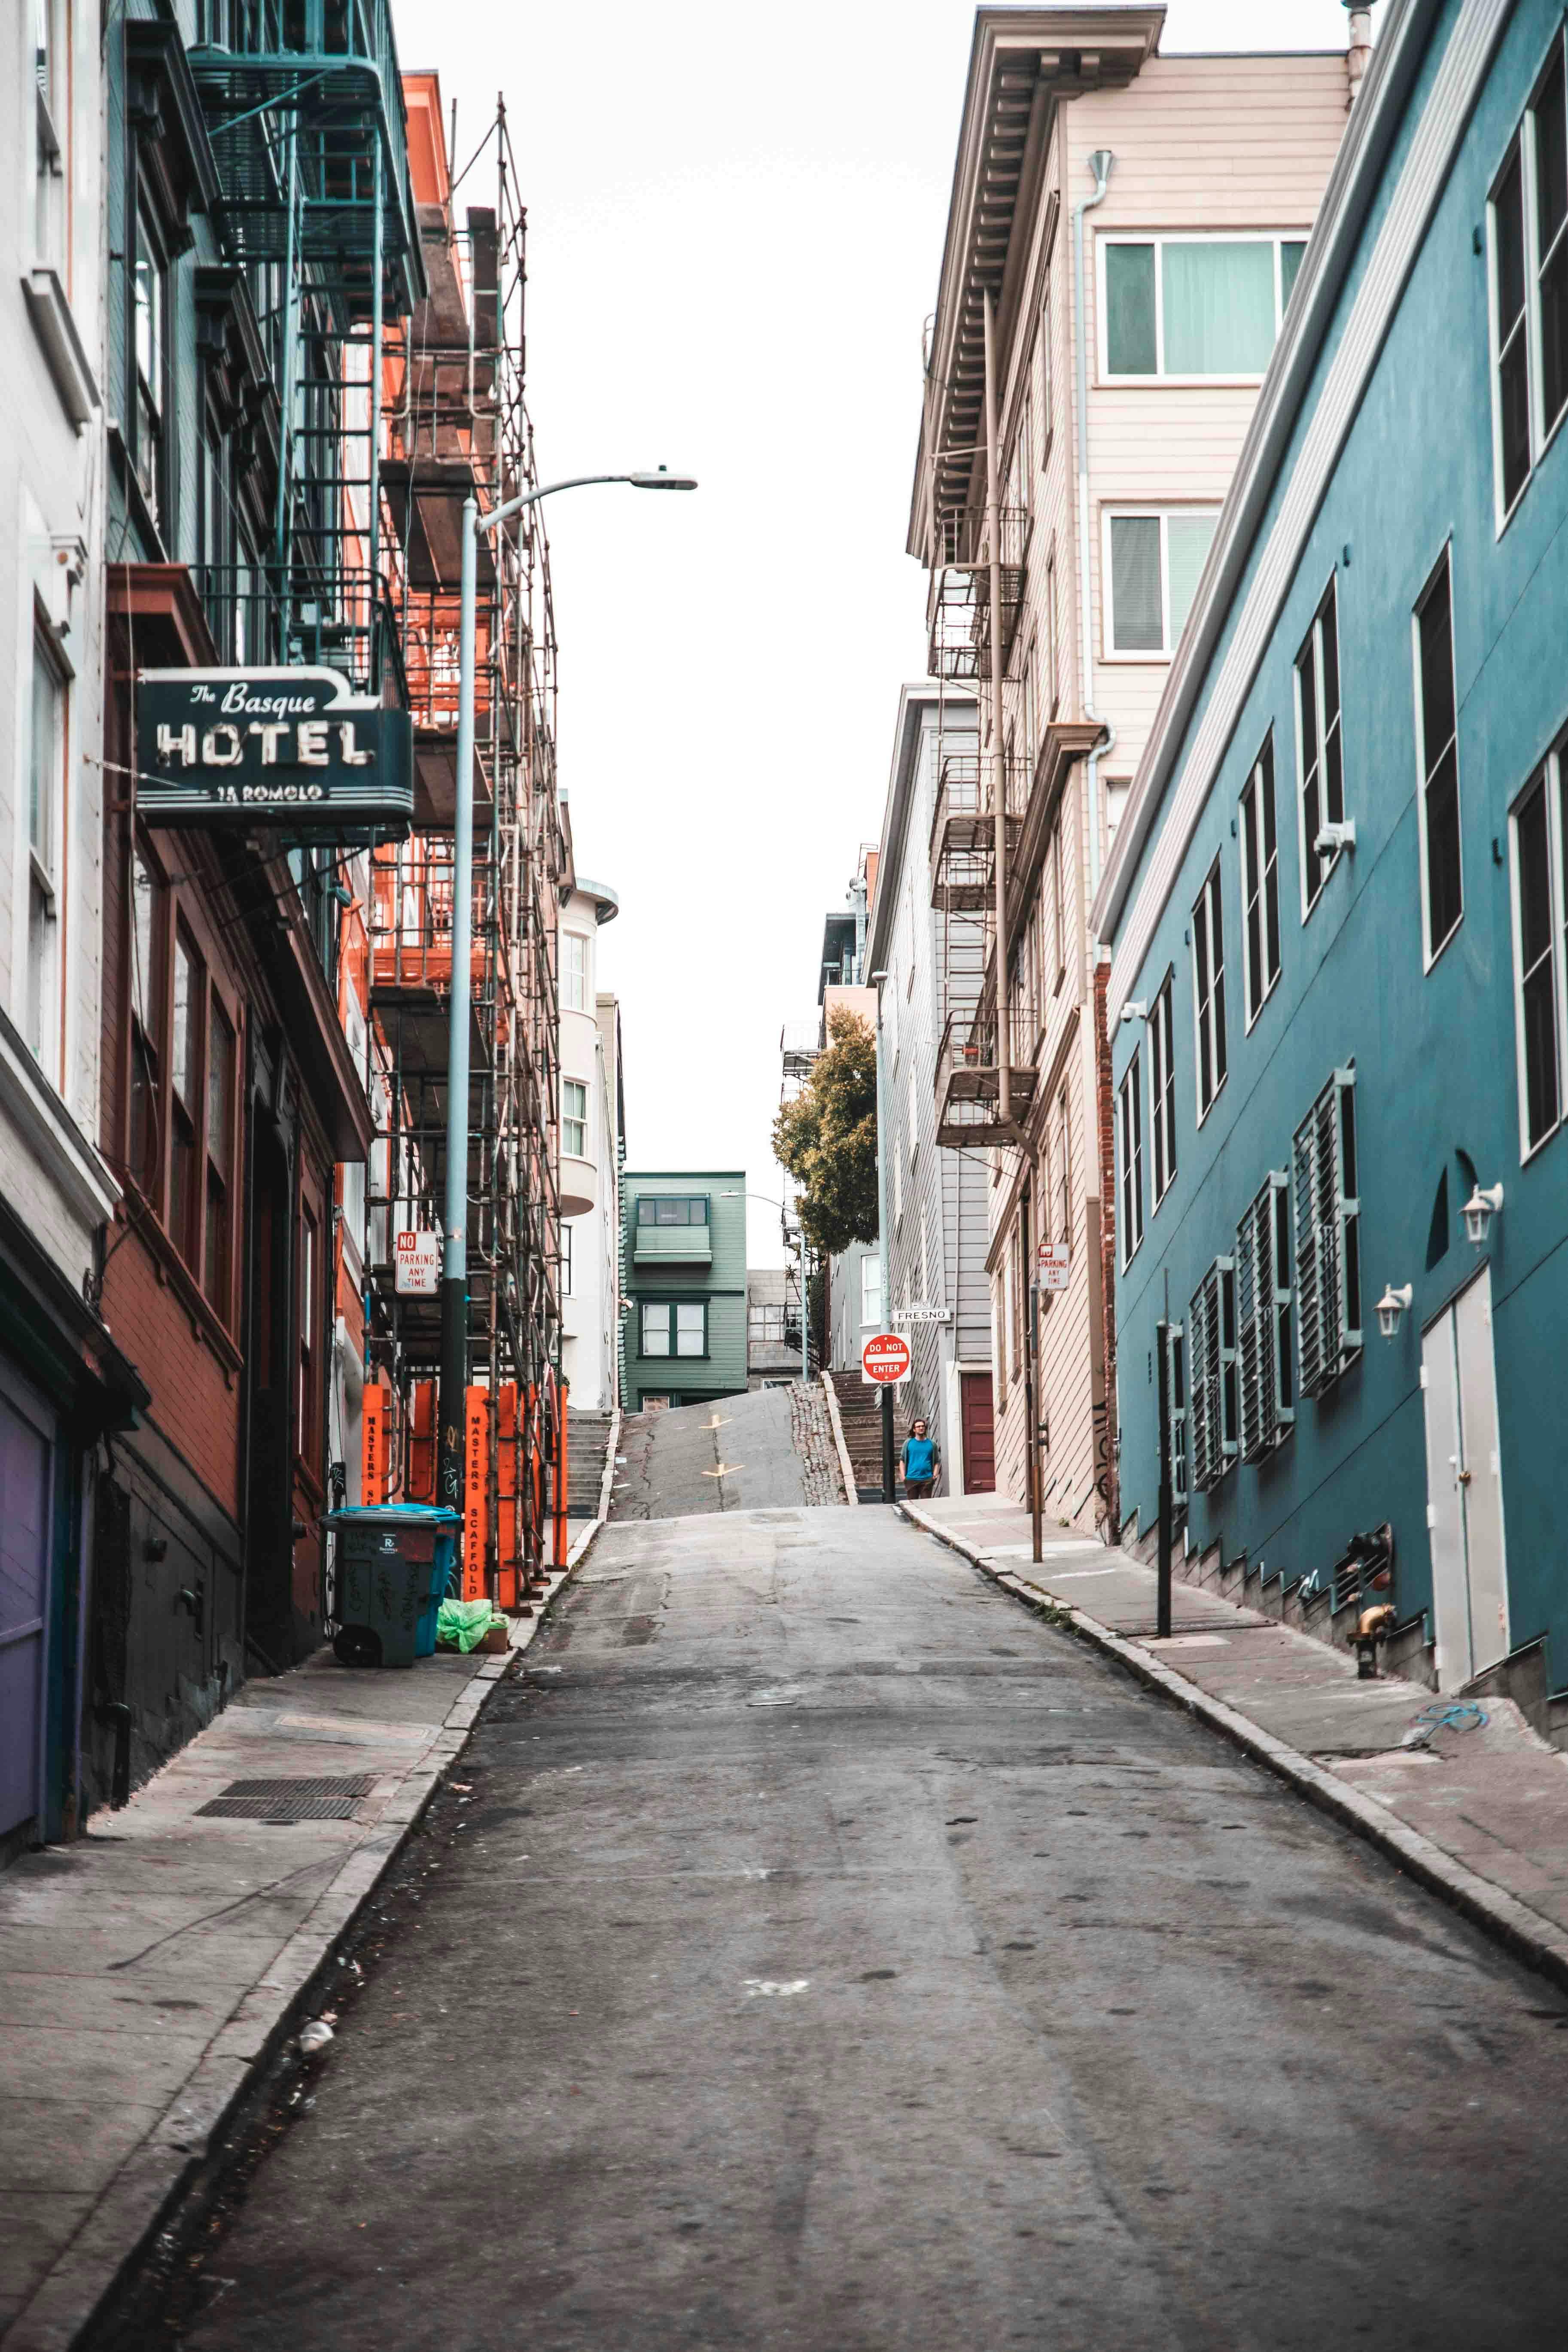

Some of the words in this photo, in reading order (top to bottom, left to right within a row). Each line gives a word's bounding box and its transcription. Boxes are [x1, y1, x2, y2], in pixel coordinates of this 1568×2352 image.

[190, 685, 215, 703] The
[220, 682, 316, 720] Basque
[157, 720, 374, 767] HOTEL
[243, 785, 322, 801] ROMOLO
[400, 1235, 414, 1249] NO
[400, 1254, 434, 1265] PARKING
[1041, 1260, 1066, 1268] PARKING
[408, 1267, 425, 1276] ANY
[407, 1278, 426, 1287] TIME
[898, 1311, 945, 1320] FRESNO
[886, 1343, 902, 1351] NOT
[873, 1364, 900, 1373] ENTER
[472, 1417, 480, 1490] MASTERS
[469, 1509, 478, 1594] SCAFFOLD
